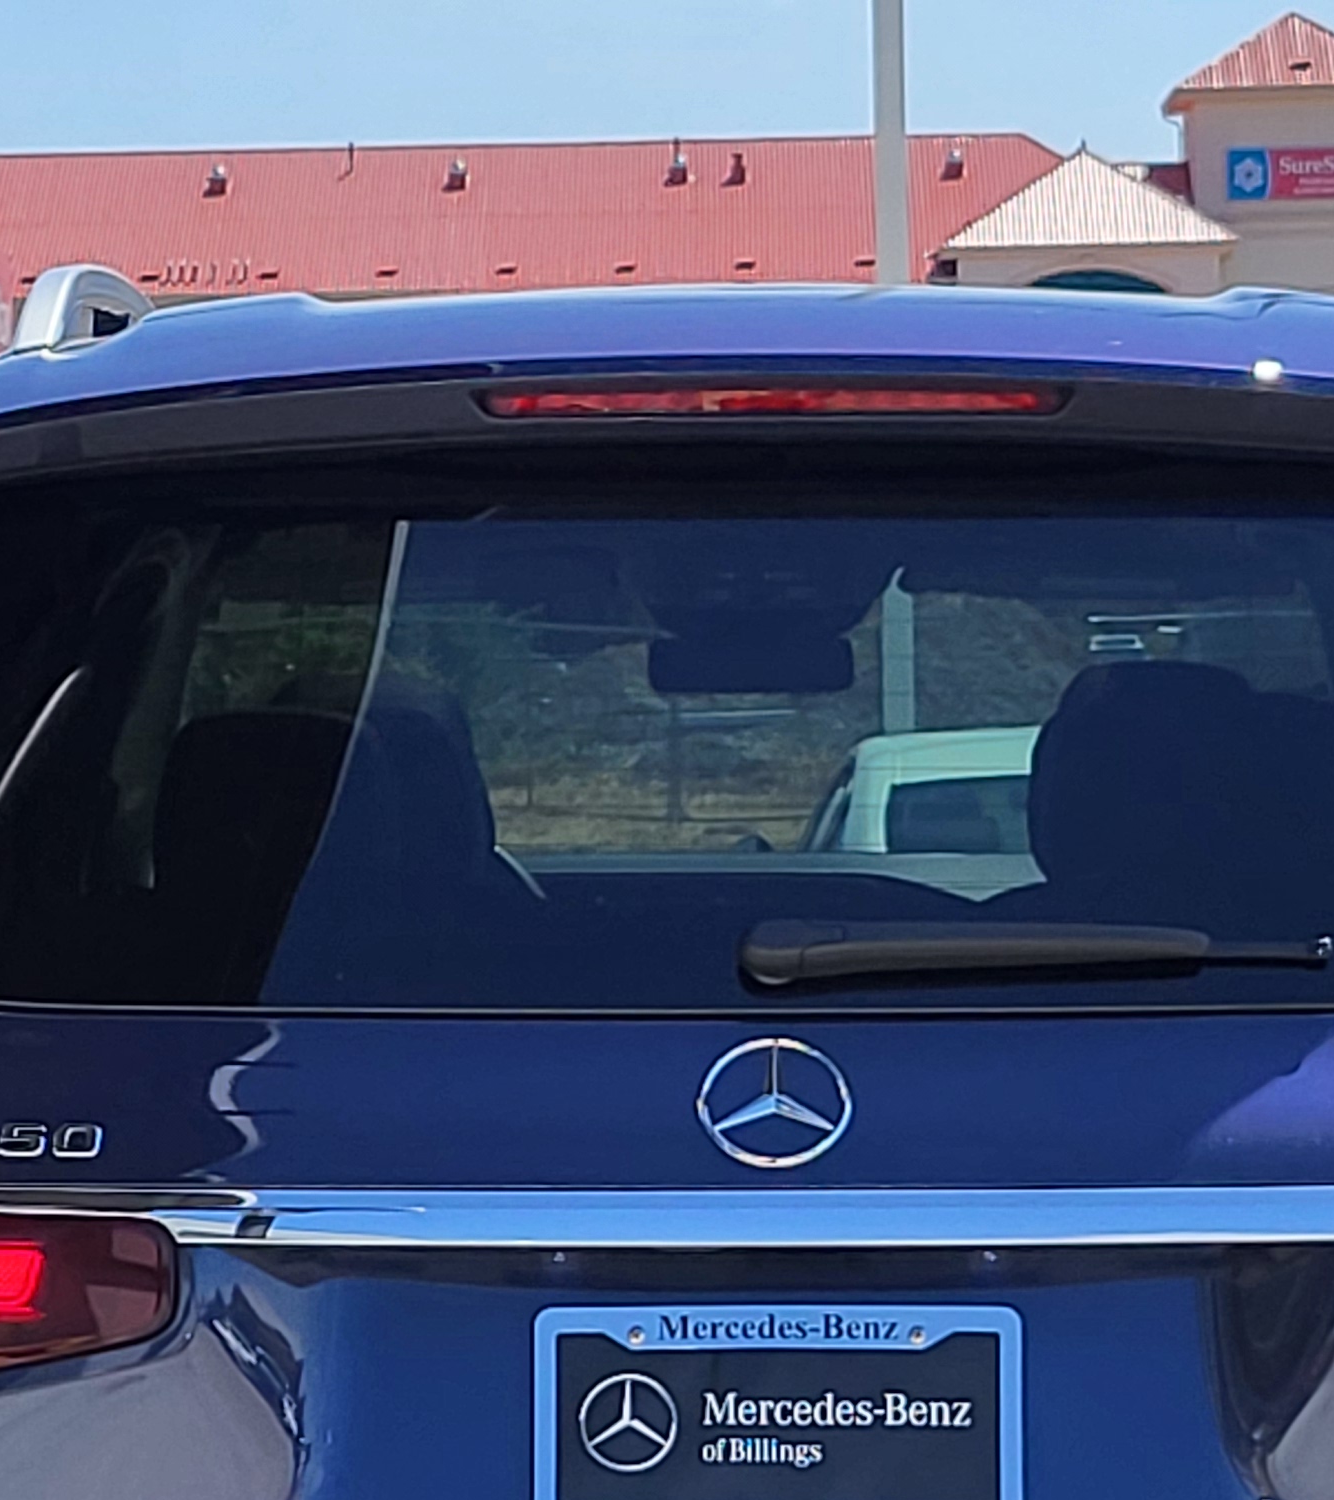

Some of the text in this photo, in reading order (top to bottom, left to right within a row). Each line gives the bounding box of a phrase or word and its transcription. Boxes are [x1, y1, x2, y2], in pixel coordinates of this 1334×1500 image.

[657, 1314, 899, 1341] Mercedes-Benz
[701, 1392, 972, 1428] Mercedes-Benz
[701, 1437, 823, 1468] of Billings
